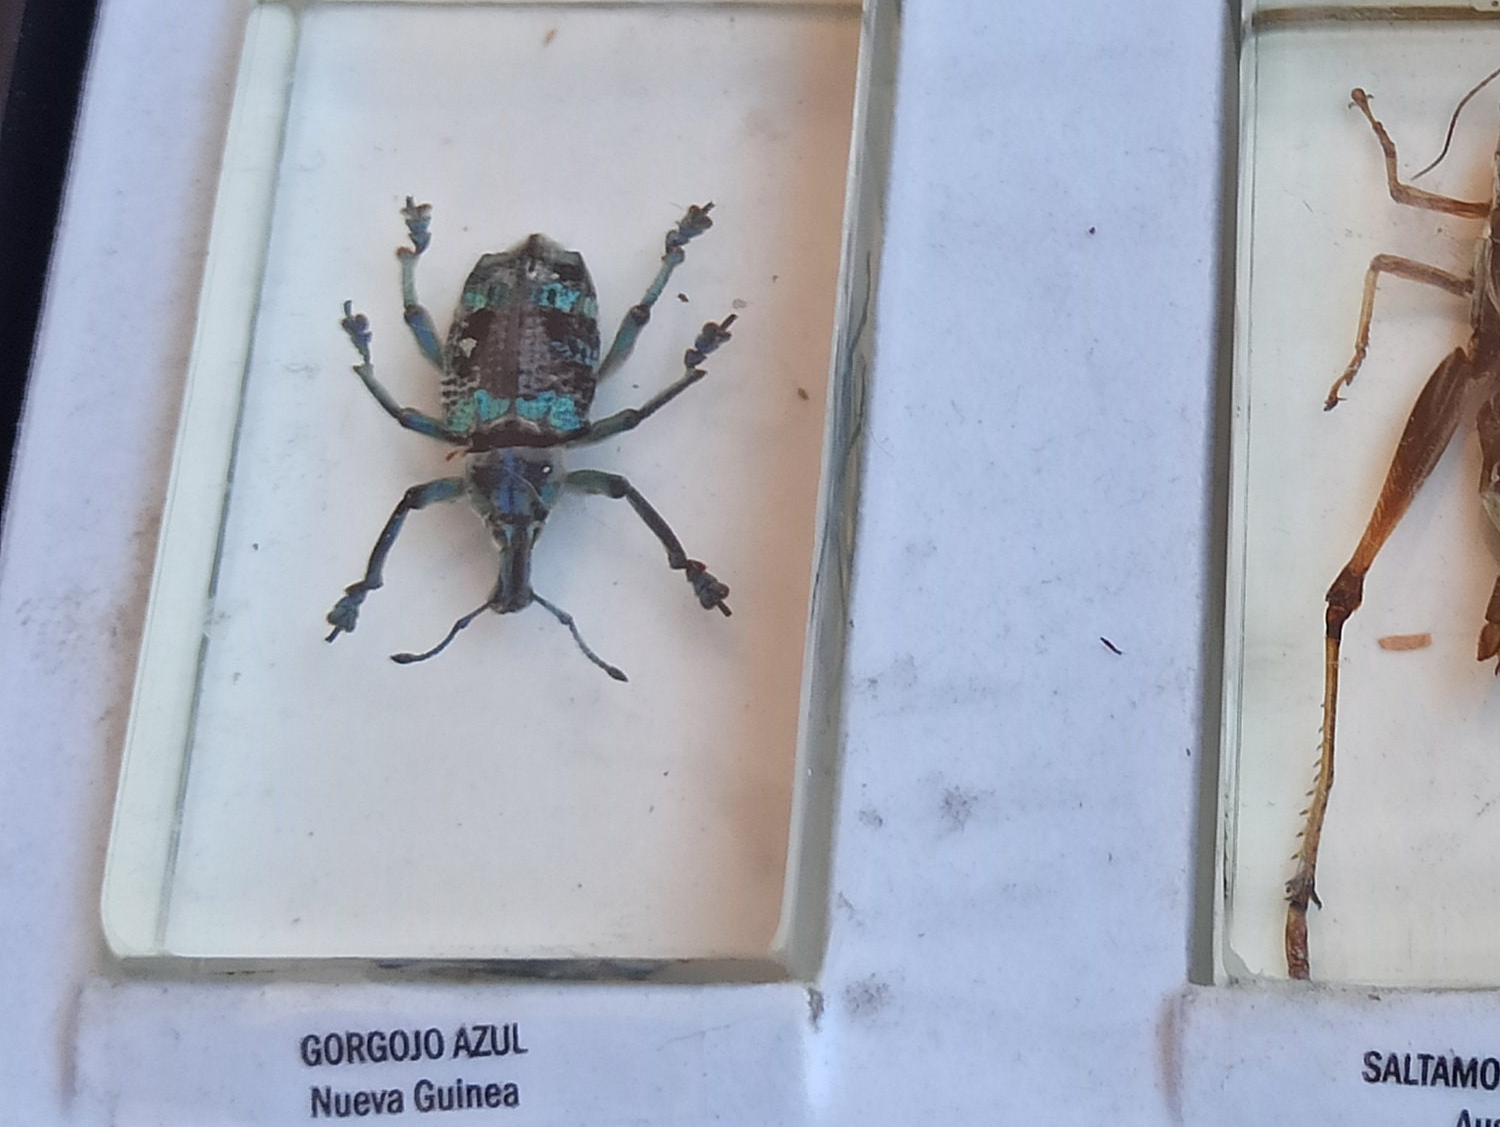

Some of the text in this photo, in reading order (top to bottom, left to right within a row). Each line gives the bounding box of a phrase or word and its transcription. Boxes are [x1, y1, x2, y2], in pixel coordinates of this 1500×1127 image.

[301, 1023, 529, 1066] GORGOJO AZUL
[311, 1078, 520, 1118] Nueva Guinea
